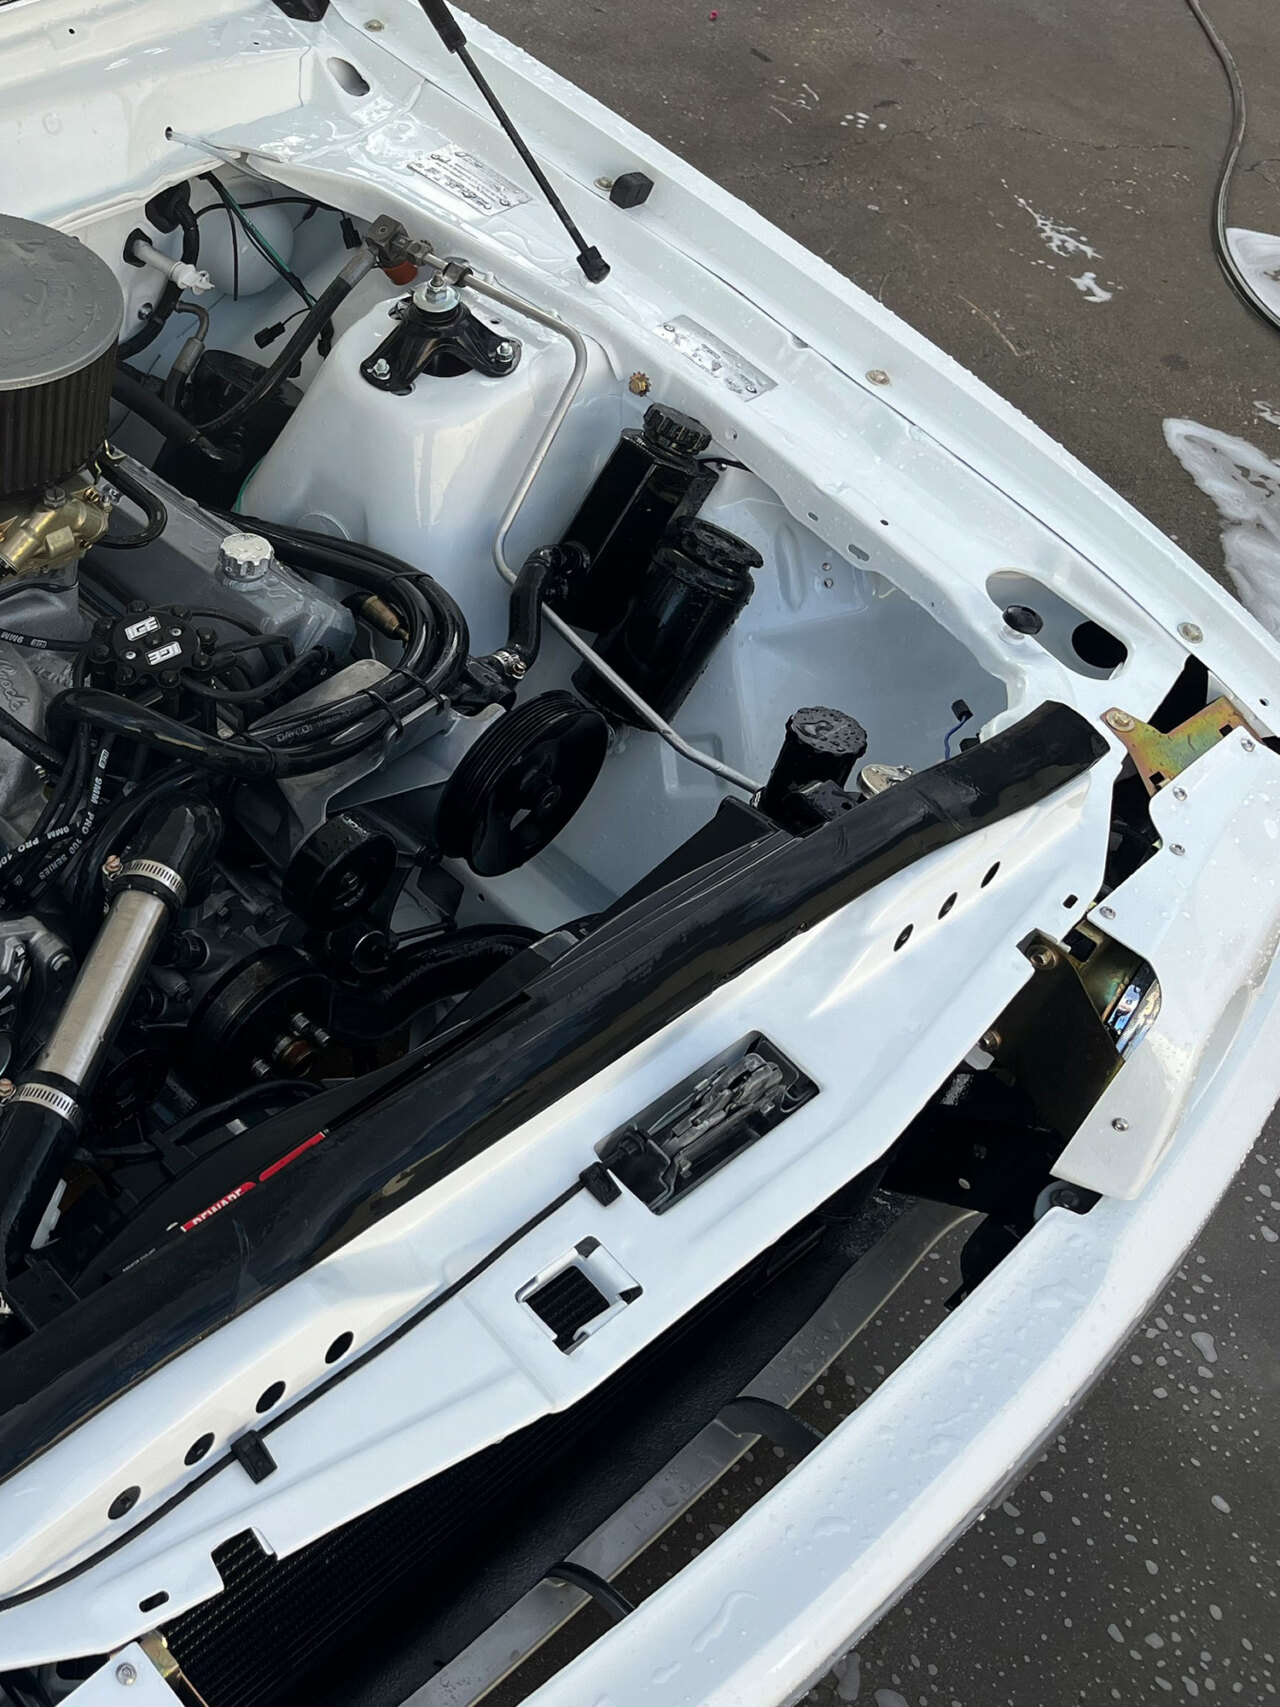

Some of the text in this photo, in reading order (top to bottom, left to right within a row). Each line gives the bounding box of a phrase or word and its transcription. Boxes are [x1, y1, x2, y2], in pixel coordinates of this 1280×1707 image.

[0, 631, 25, 644] 9MM
[90, 776, 103, 805] 9MM
[81, 811, 95, 835] PRO
[46, 825, 70, 840] 9MM
[17, 837, 40, 853] PRO
[68, 838, 83, 855] 100
[38, 853, 68, 880] SERIES
